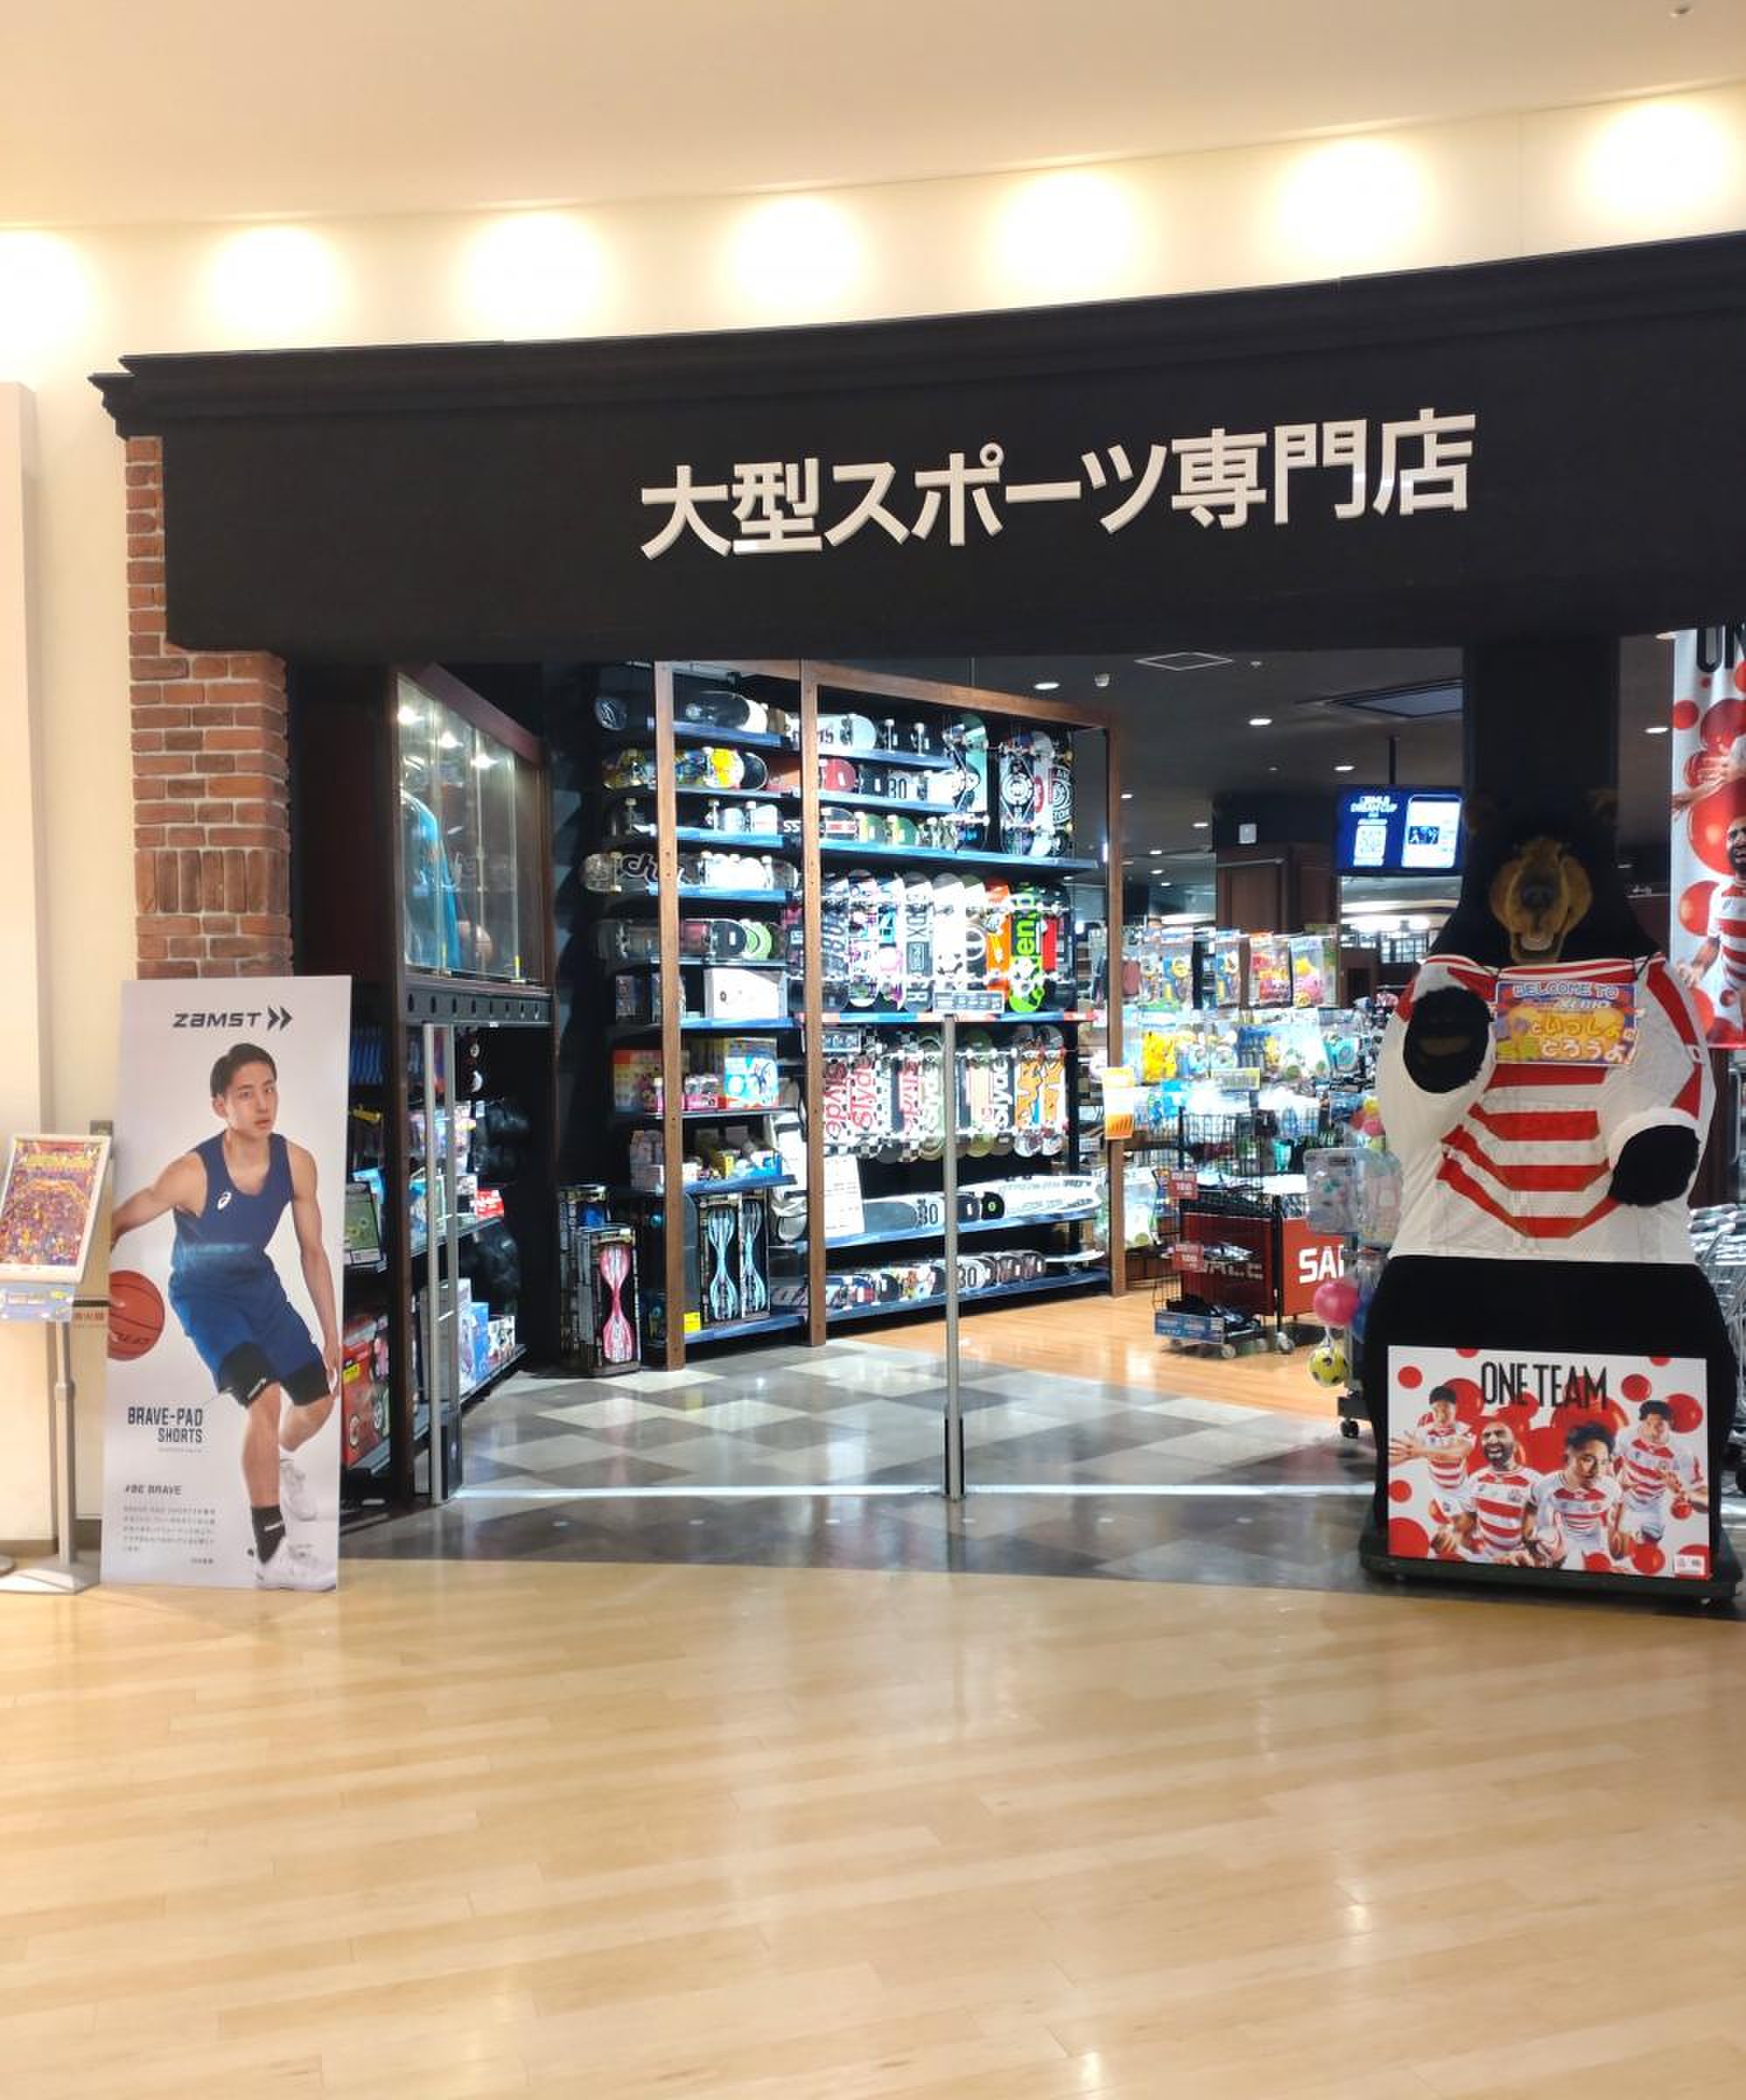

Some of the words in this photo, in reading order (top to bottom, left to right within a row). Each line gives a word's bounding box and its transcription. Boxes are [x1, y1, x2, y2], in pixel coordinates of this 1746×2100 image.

[640, 409, 1476, 558] 大型スポーツ専門店
[1481, 1362, 1528, 1404] ONE
[1532, 1364, 1608, 1409] TEAM
[128, 1407, 203, 1426] BRAVE-PAD
[157, 1428, 203, 1443] SHORTS
[148, 1484, 183, 1495] BRAVE
